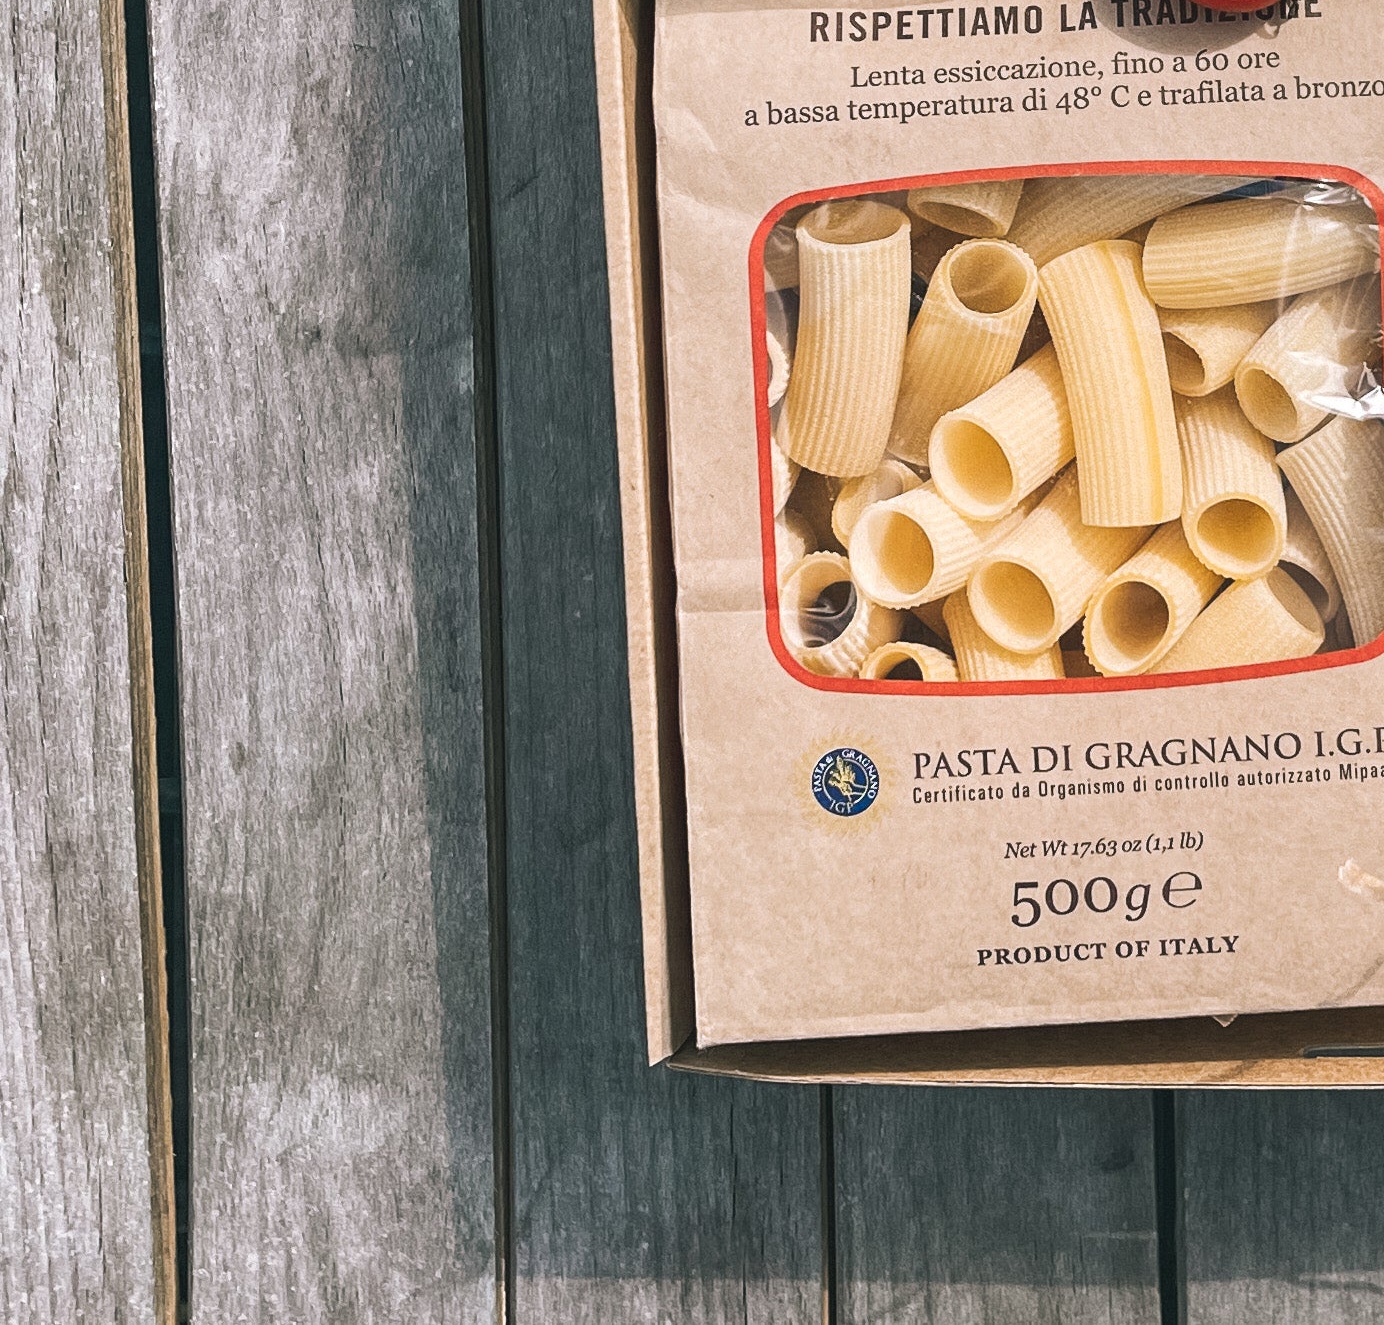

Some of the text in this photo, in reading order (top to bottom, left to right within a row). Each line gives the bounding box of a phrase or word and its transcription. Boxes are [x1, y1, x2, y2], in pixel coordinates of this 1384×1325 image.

[810, 4, 1043, 42] RISPETTIAMO
[1059, 1, 1098, 33] LA
[851, 49, 1280, 89] Lenta essiccazione, fino a 60 ore
[745, 108, 760, 127] a
[766, 97, 839, 126] bassa
[846, 92, 1015, 125] temperatura
[1021, 85, 1049, 112] di
[1111, 85, 1131, 107] C
[1137, 90, 1152, 106] e
[1160, 80, 1266, 105] trafilata
[1273, 84, 1288, 100] a
[912, 748, 1021, 779] PASTA
[1032, 744, 1073, 773] DI
[1085, 732, 1301, 770] GRAGNANO
[814, 762, 826, 792] PASTA
[912, 782, 1004, 804] Certificato
[1010, 781, 1030, 798] da
[1038, 777, 1126, 802] Organismo
[1133, 774, 1148, 793] di
[1155, 770, 1229, 792] controllo
[1238, 765, 1331, 788] autorizzato
[830, 800, 853, 813] IGP
[1004, 839, 1036, 860] Net
[1041, 837, 1067, 857] Wt
[1071, 836, 1120, 858] 17.63
[1122, 836, 1141, 854] oz
[977, 936, 1239, 966] PRODUCT OF ITALY
